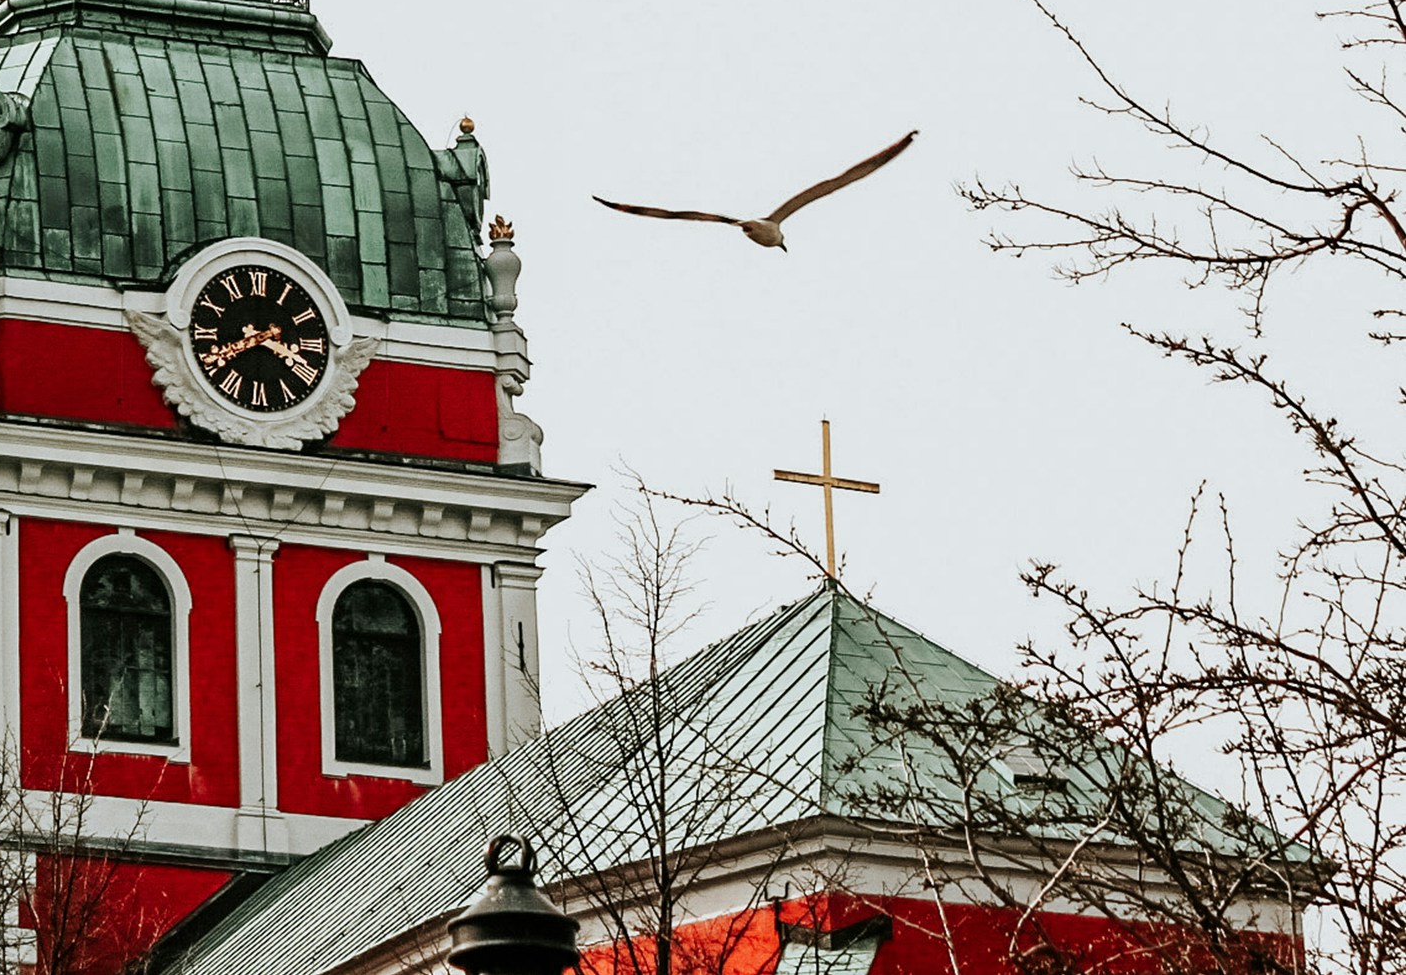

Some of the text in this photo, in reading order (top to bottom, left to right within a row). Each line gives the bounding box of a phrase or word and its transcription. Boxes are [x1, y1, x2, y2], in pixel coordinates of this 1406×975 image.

[220, 274, 243, 303] XI
[248, 271, 268, 297] XII
[276, 282, 293, 306] I
[200, 294, 225, 318] X
[292, 307, 316, 326] II
[194, 323, 219, 341] IX
[299, 337, 323, 354] III
[218, 369, 243, 399] VII
[251, 380, 269, 406] VI
[279, 378, 296, 403] V
